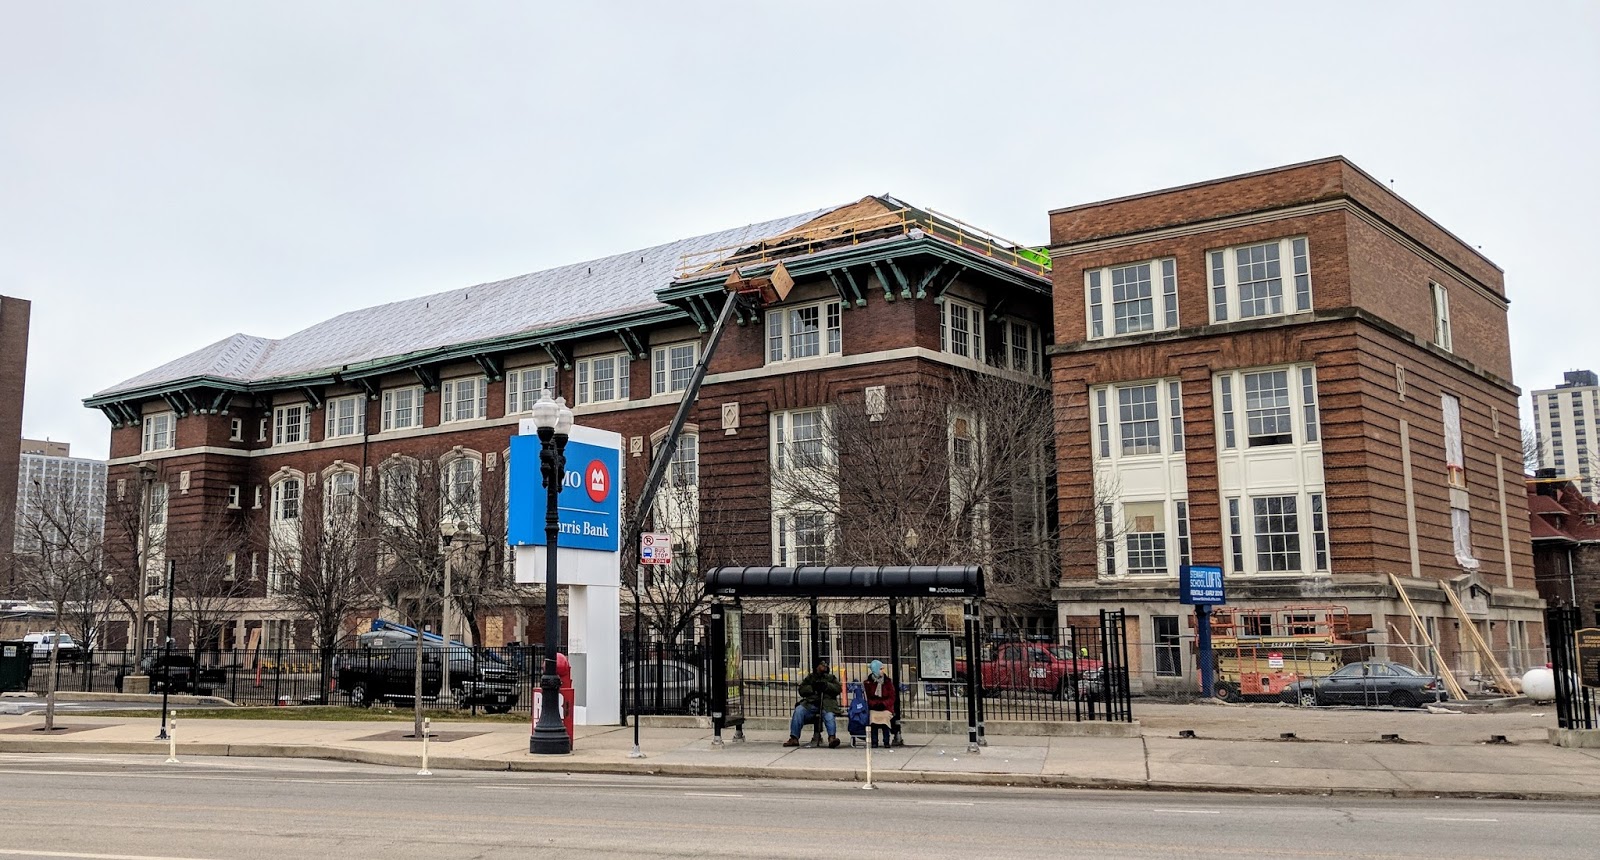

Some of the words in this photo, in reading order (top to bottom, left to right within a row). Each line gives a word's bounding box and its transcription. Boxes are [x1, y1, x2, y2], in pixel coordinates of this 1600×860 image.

[562, 470, 581, 488] MO
[557, 520, 581, 535] arris
[583, 521, 609, 538] Bank
[1190, 570, 1206, 579] STEWART
[1206, 571, 1222, 588] LOFTS
[1190, 579, 1206, 588] SCHOOL
